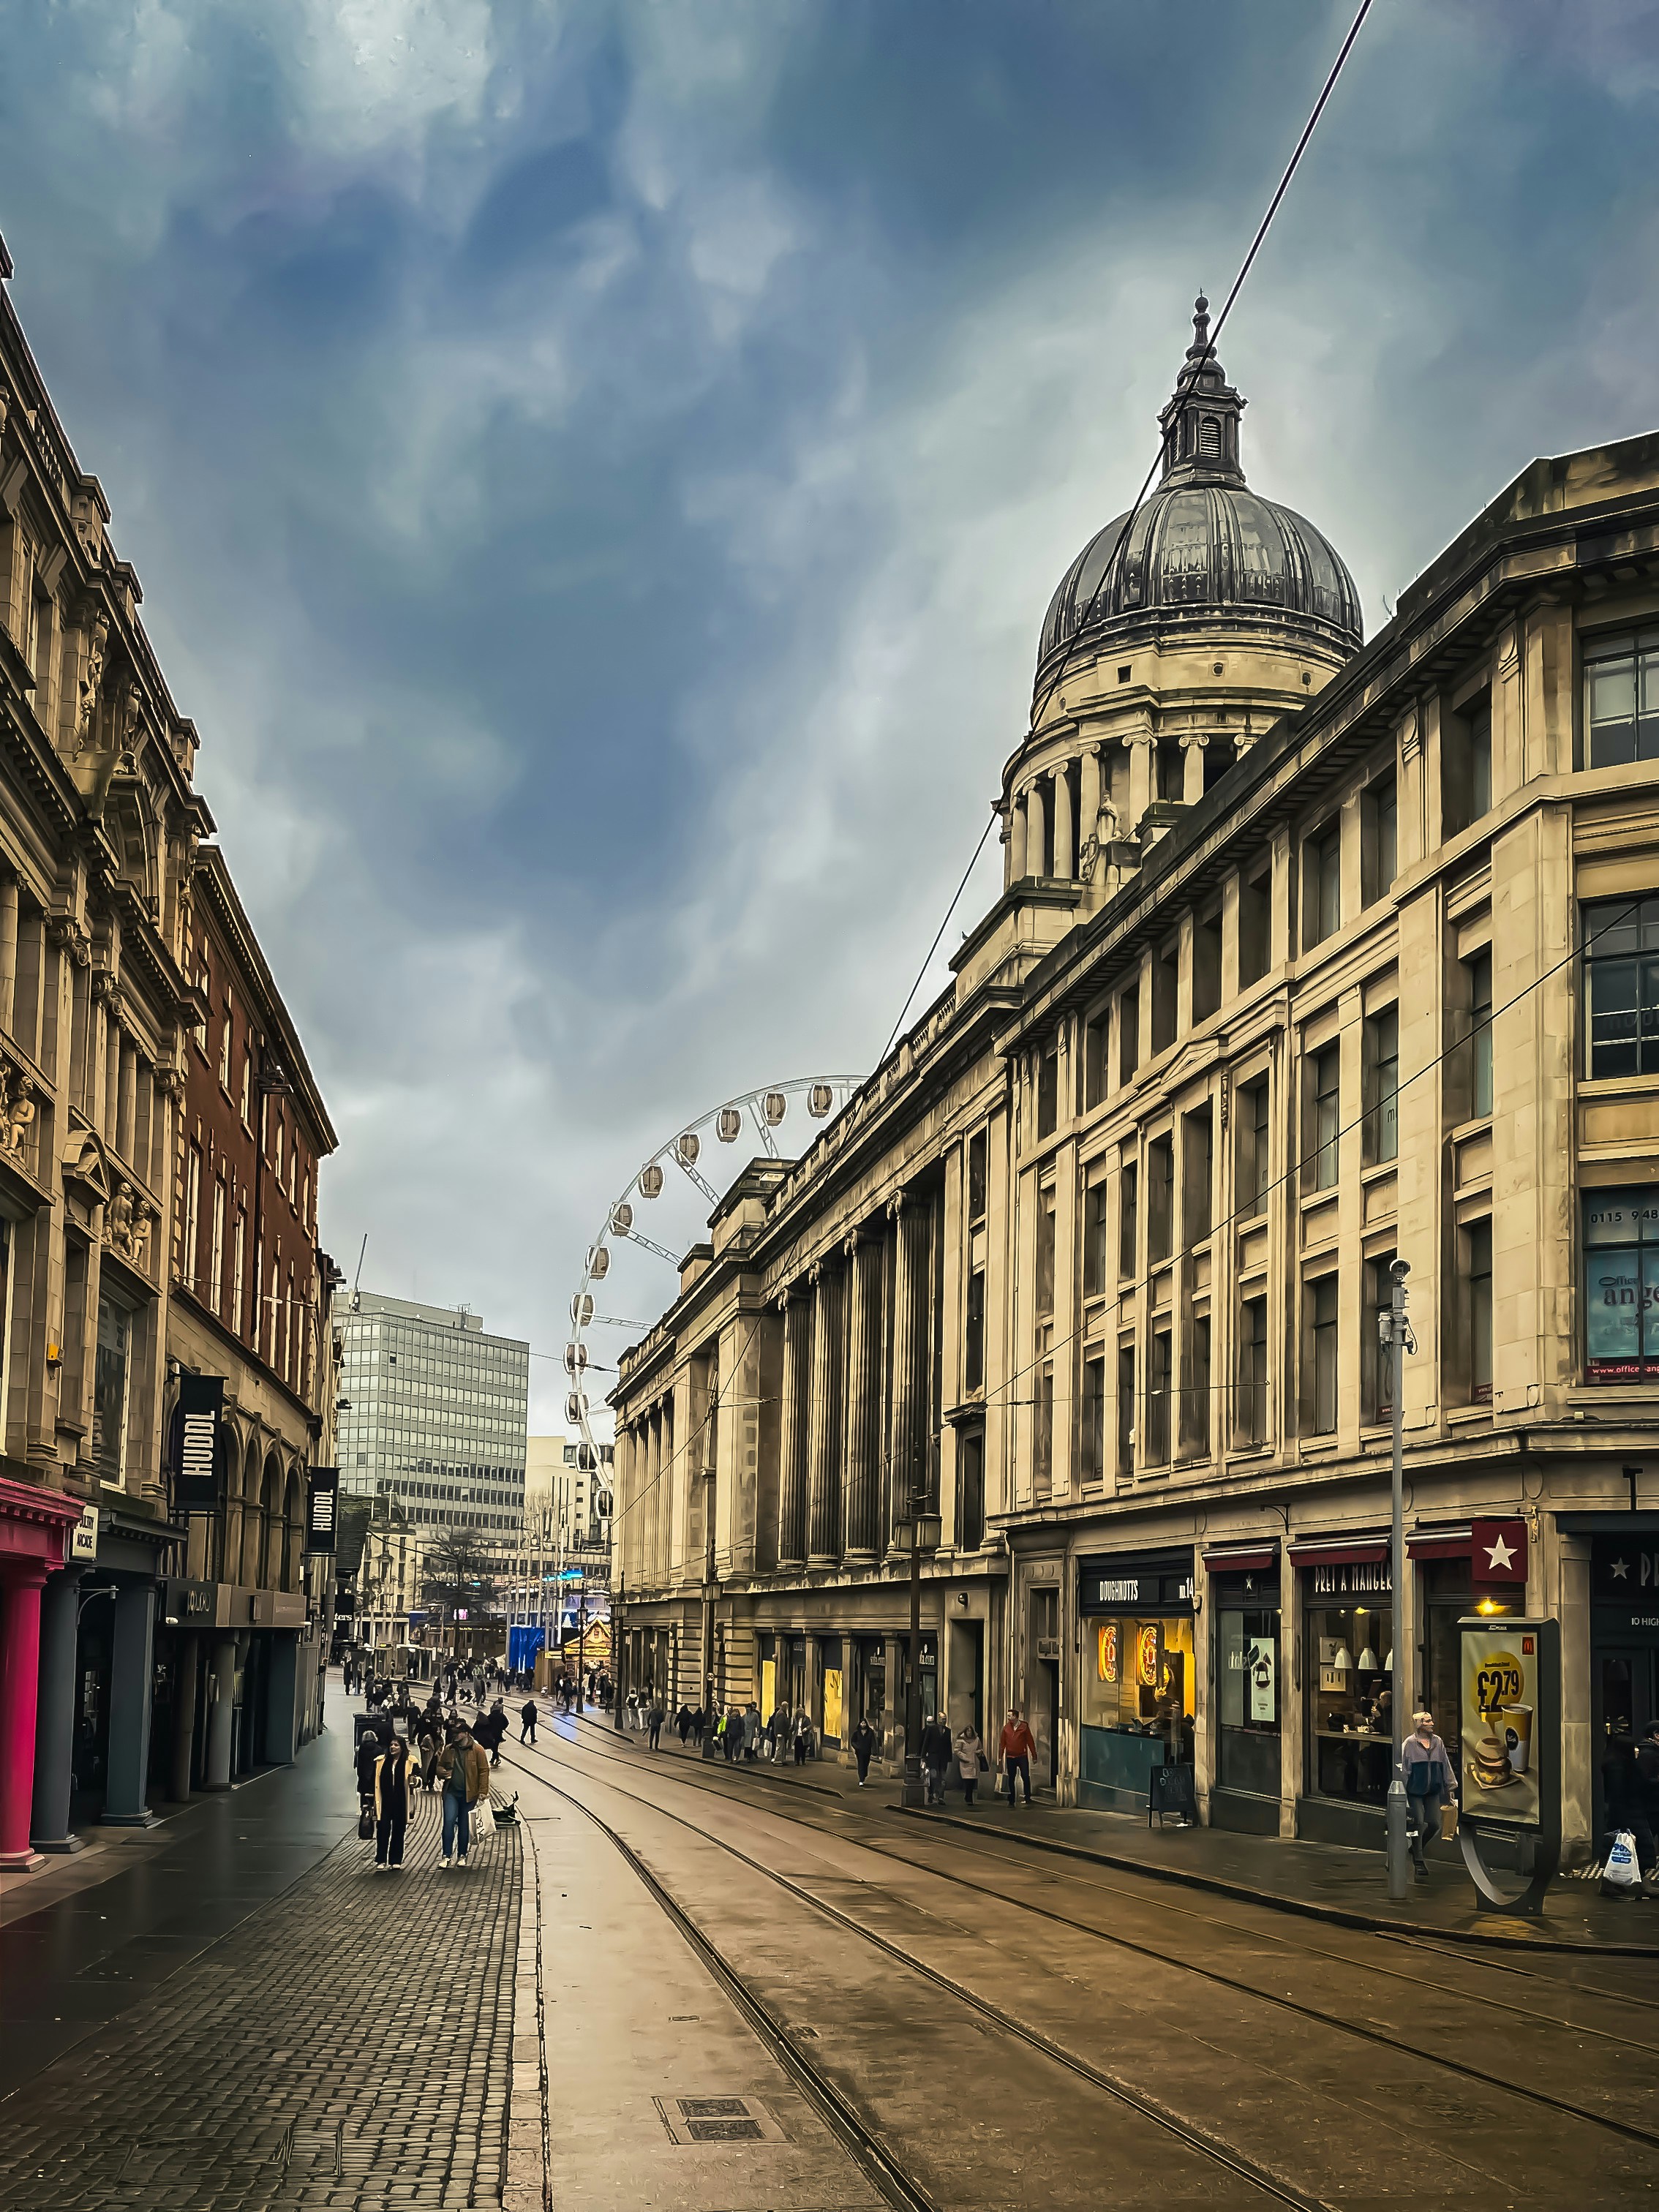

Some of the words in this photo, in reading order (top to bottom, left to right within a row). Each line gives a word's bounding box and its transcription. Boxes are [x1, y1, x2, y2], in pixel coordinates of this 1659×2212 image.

[1591, 1211, 1622, 1224] 0115
[182, 1410, 215, 1476] HUDDL
[312, 1489, 334, 1531] HUDDL
[1315, 1565, 1336, 1593] PRET
[1341, 1565, 1347, 1591] A
[1352, 1562, 1393, 1591] MANGER
[1477, 1669, 1520, 1713] £2.79
